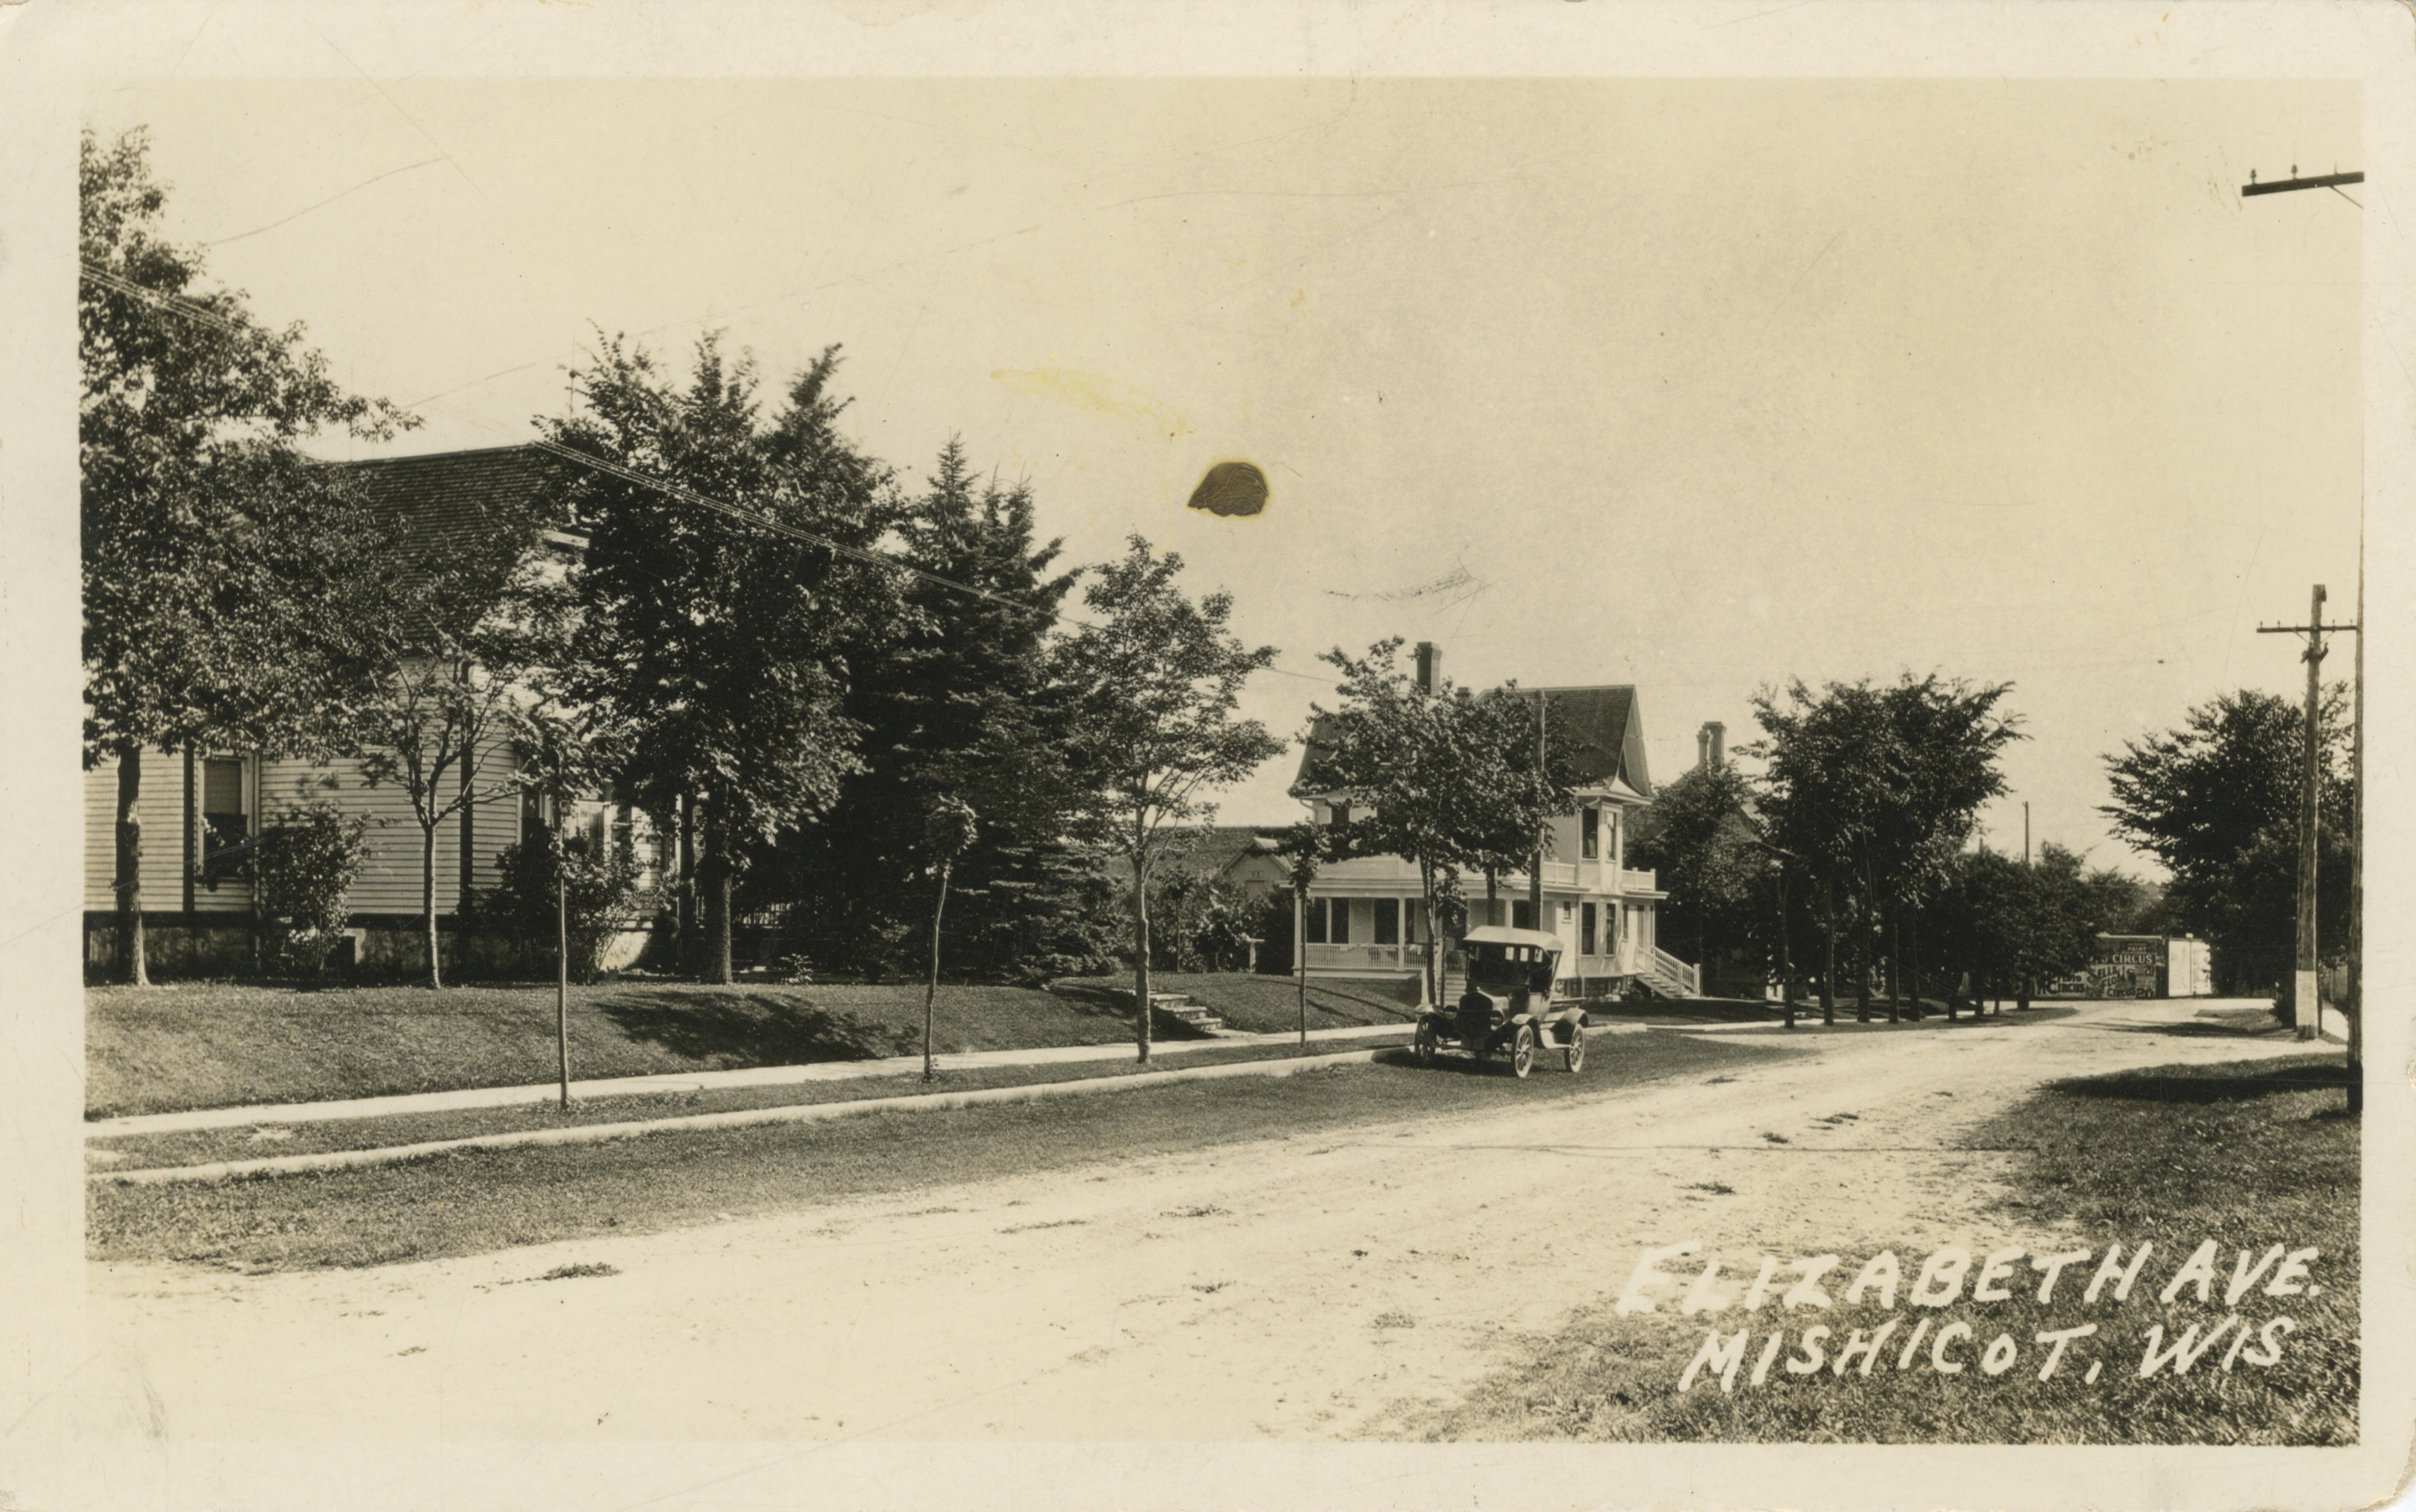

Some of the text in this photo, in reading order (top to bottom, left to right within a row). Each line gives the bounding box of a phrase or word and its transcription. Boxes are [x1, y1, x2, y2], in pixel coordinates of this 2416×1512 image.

[2112, 953, 2153, 964] CIRCUS
[2087, 966, 2118, 984] SELLS
[2046, 977, 2085, 994] CIRCUS
[2136, 988, 2154, 999] 20
